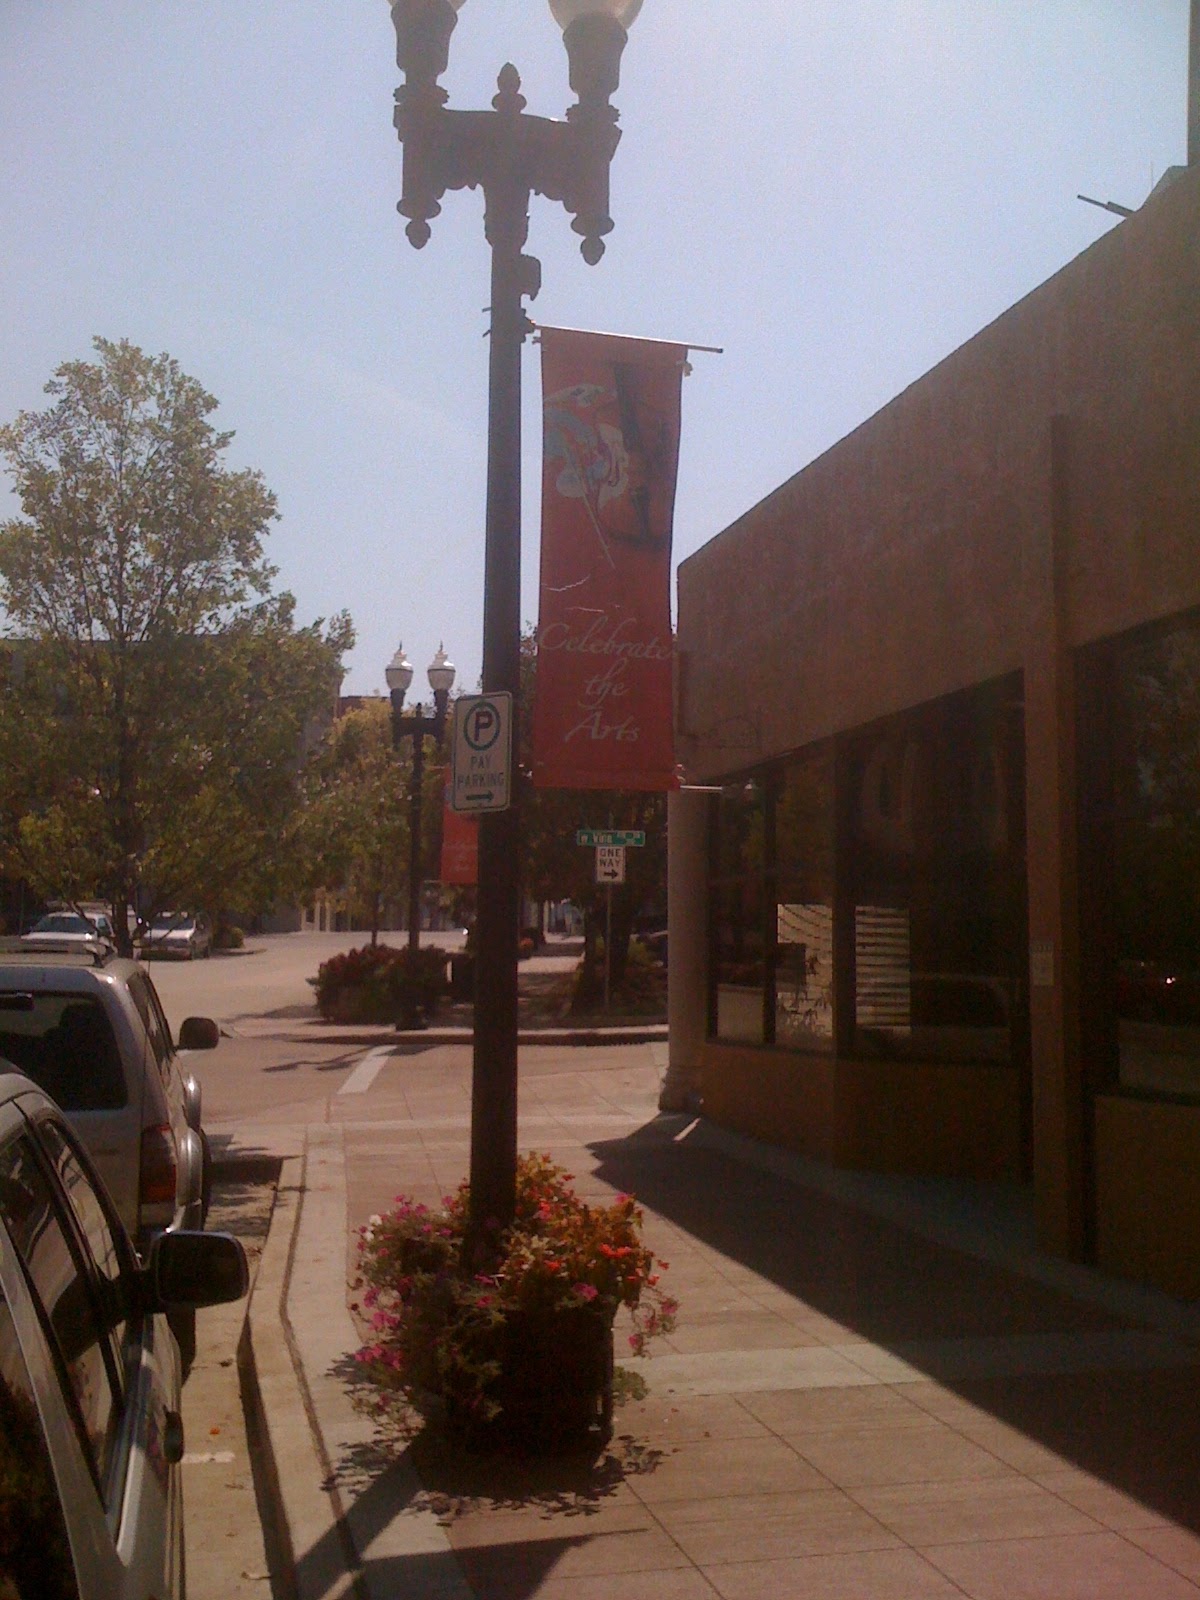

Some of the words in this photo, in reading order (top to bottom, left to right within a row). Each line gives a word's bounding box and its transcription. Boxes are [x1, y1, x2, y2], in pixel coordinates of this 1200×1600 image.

[538, 615, 672, 660] Celebrate
[577, 657, 630, 709] the
[473, 710, 493, 742] P
[564, 705, 640, 743] Arts
[470, 755, 493, 770] PAY
[457, 772, 505, 789] PARKING
[599, 848, 621, 858] ONE
[599, 858, 621, 868] WAY
